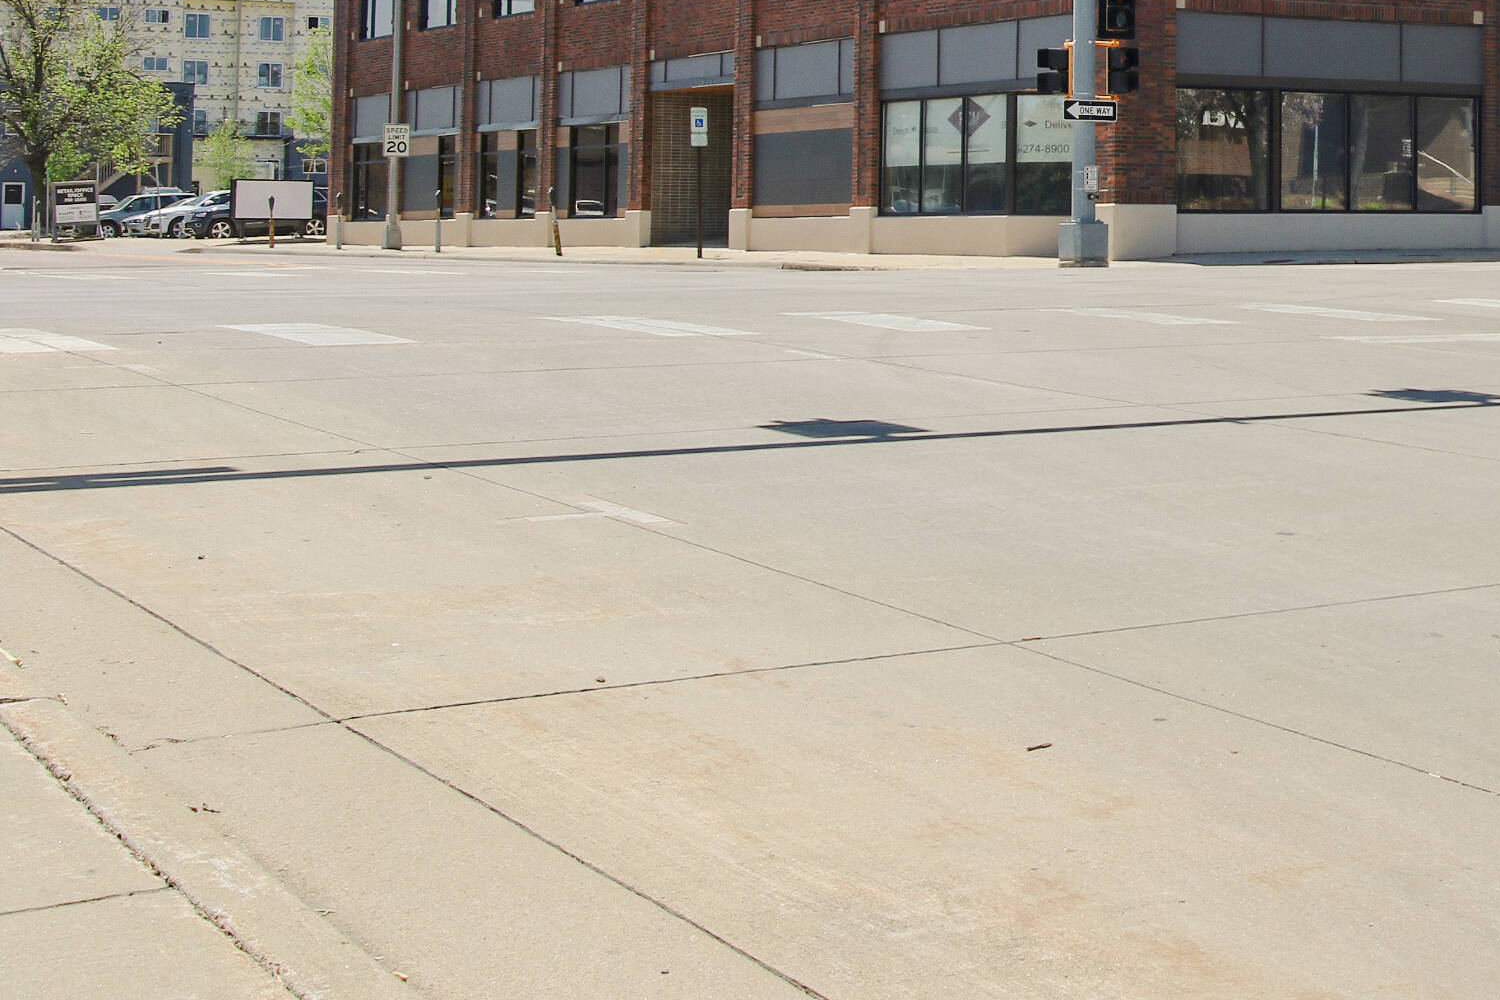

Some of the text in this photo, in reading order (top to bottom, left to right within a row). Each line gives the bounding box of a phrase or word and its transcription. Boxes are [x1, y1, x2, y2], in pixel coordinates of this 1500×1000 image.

[1079, 106, 1111, 116] ONE WAY
[1045, 119, 1073, 129] Delive
[386, 141, 407, 153] 20
